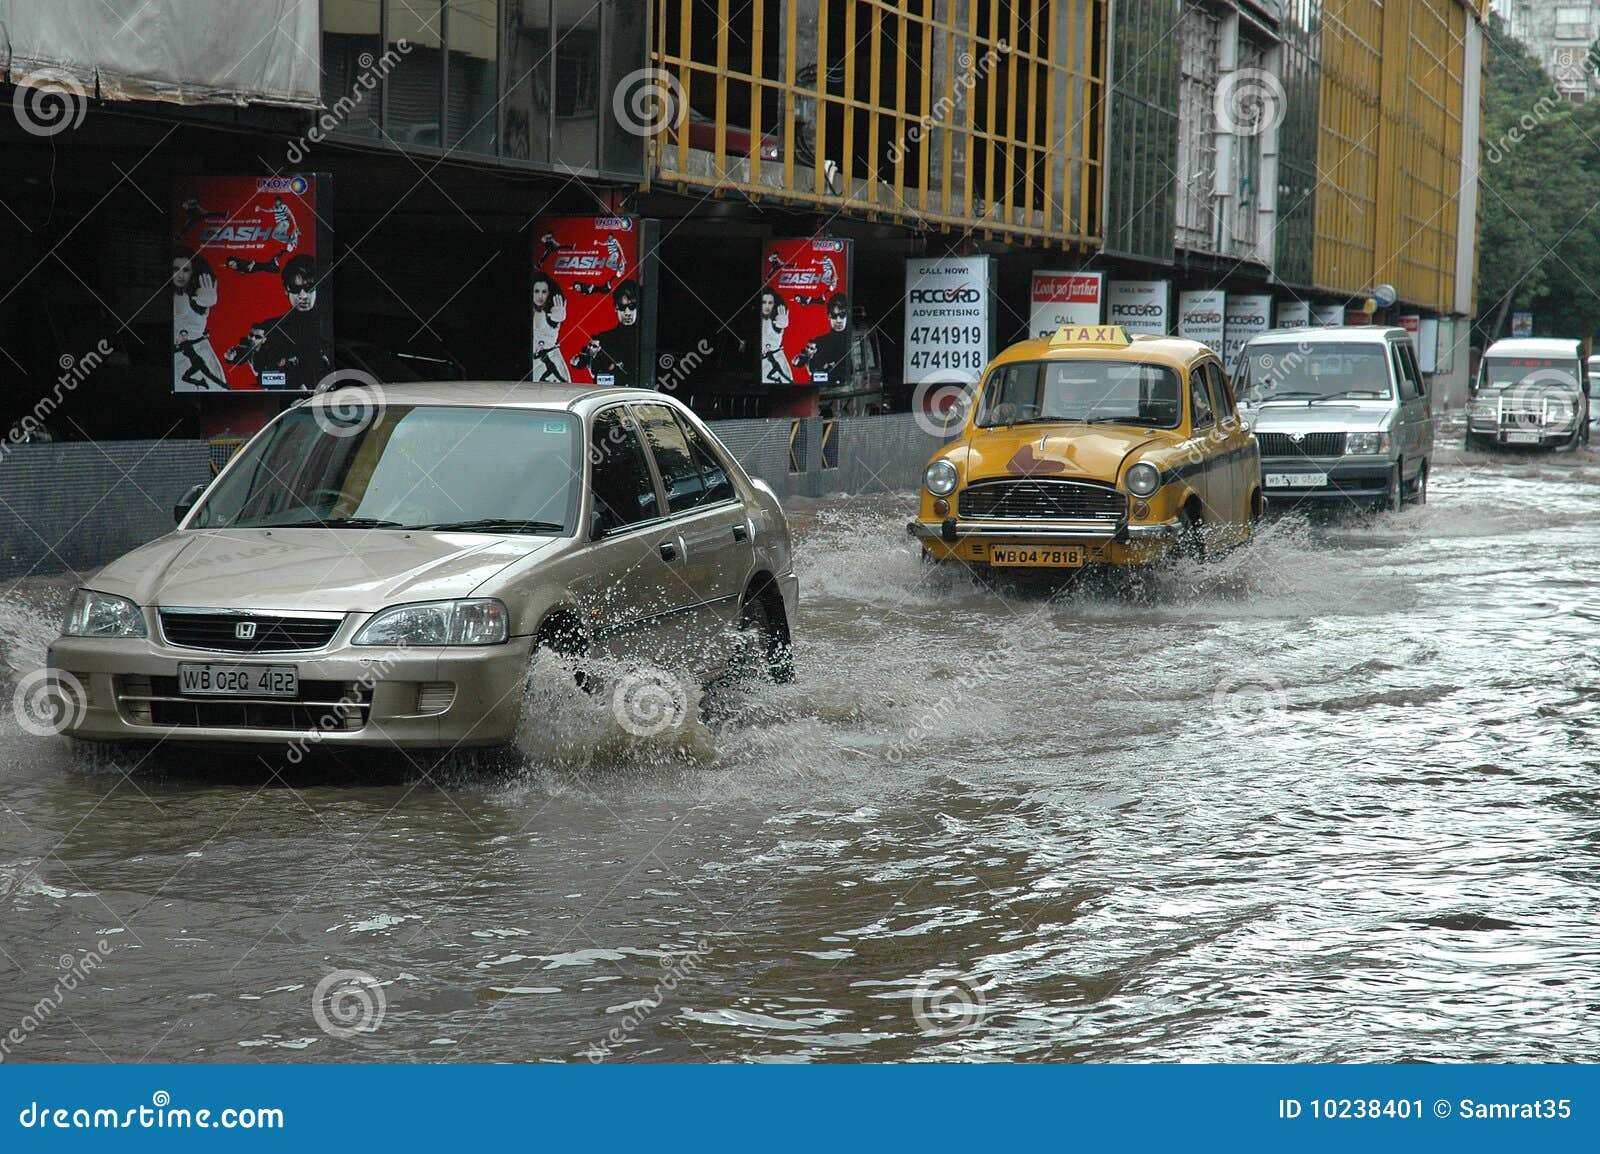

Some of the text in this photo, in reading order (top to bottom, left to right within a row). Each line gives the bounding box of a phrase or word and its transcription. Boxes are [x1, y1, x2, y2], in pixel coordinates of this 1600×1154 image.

[256, 178, 291, 189] INOX
[200, 226, 274, 242] CASH
[554, 256, 607, 269] CASH
[945, 267, 969, 275] NOW!
[779, 272, 822, 284] CASH
[1034, 279, 1056, 295] Look
[1065, 278, 1098, 300] further
[909, 289, 981, 304] ACCORD
[912, 308, 980, 317] ADVERTISING
[1112, 304, 1163, 317] ACCORD
[1054, 315, 1075, 324] CALL
[1183, 312, 1222, 324] ACCORD
[910, 326, 981, 345] 4741919
[1063, 327, 1115, 341] TAXI
[910, 350, 982, 369] 4741918
[1042, 551, 1079, 563] 7818
[183, 670, 211, 690] WB
[258, 672, 295, 692] 4122
